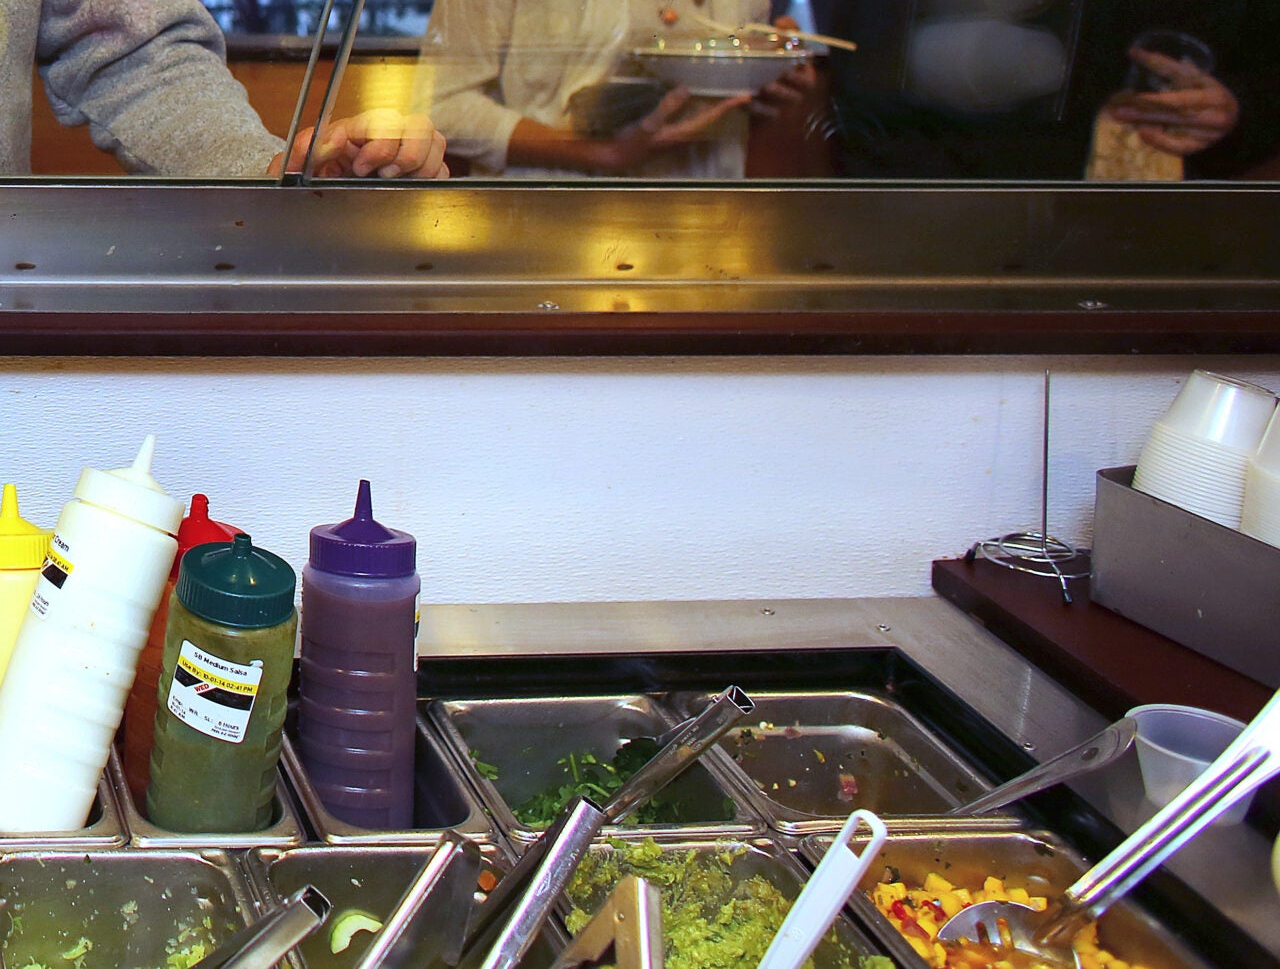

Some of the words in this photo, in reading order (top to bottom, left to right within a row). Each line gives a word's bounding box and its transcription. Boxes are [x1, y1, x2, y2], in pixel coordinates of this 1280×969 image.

[182, 660, 191, 669] Use
[204, 656, 228, 671] Medium
[230, 668, 248, 676] Salsa
[194, 683, 210, 692] WED
